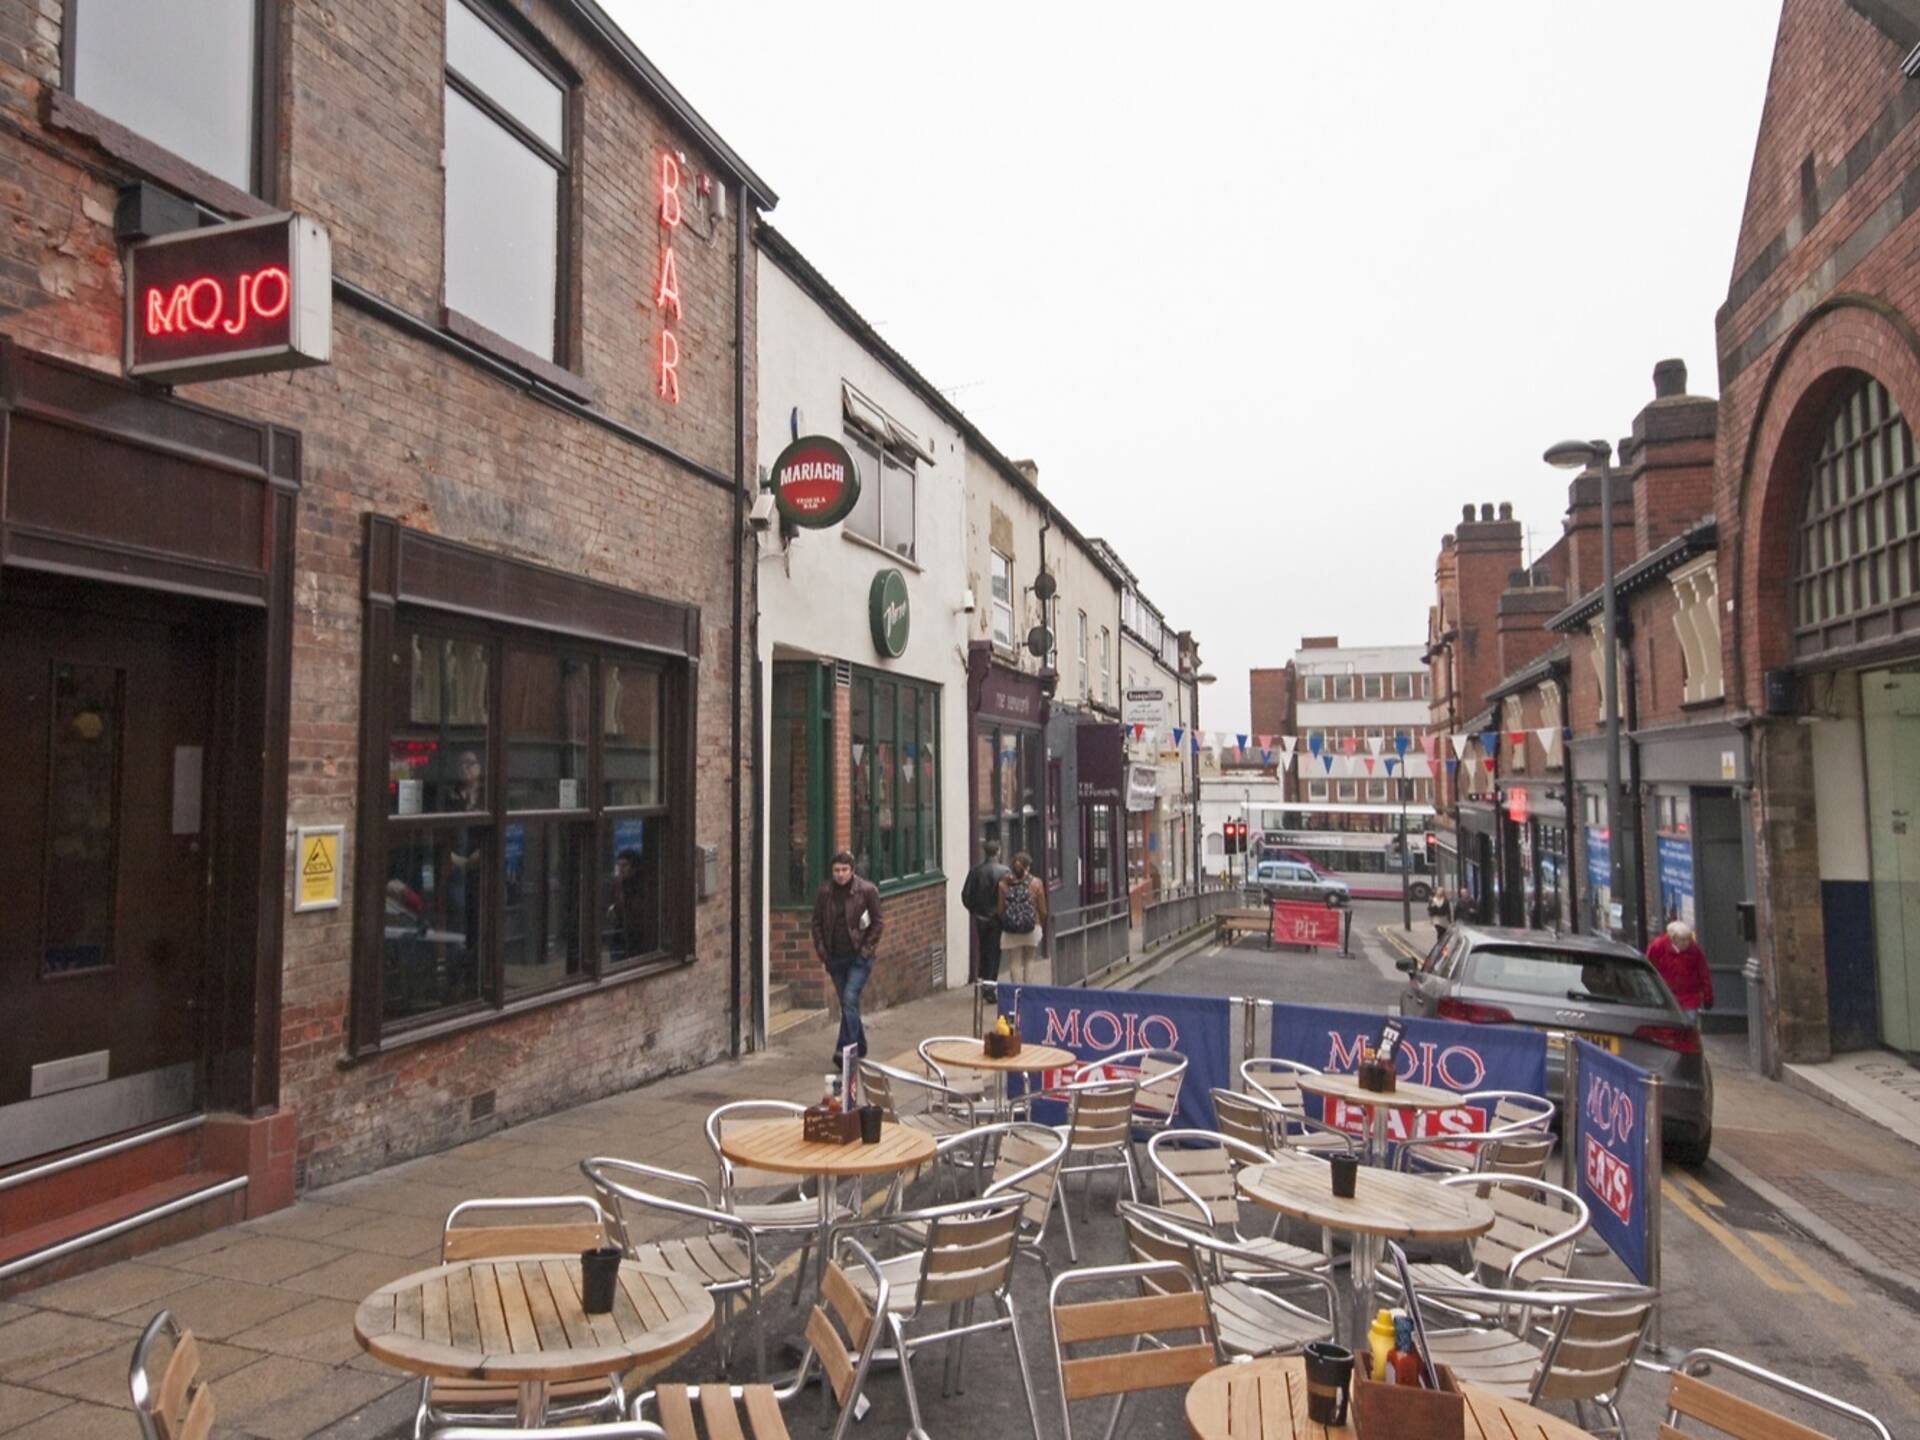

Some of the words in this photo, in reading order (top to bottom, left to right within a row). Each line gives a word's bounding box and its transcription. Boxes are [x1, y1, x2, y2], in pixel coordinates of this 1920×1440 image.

[147, 266, 289, 335] MOJO
[657, 153, 682, 404] BAR
[780, 461, 845, 487] MARIACHI
[1294, 918, 1320, 939] PIT
[1041, 1007, 1179, 1062] MOJO
[1586, 1072, 1634, 1148] MOJO
[1587, 1138, 1628, 1212] EATS
